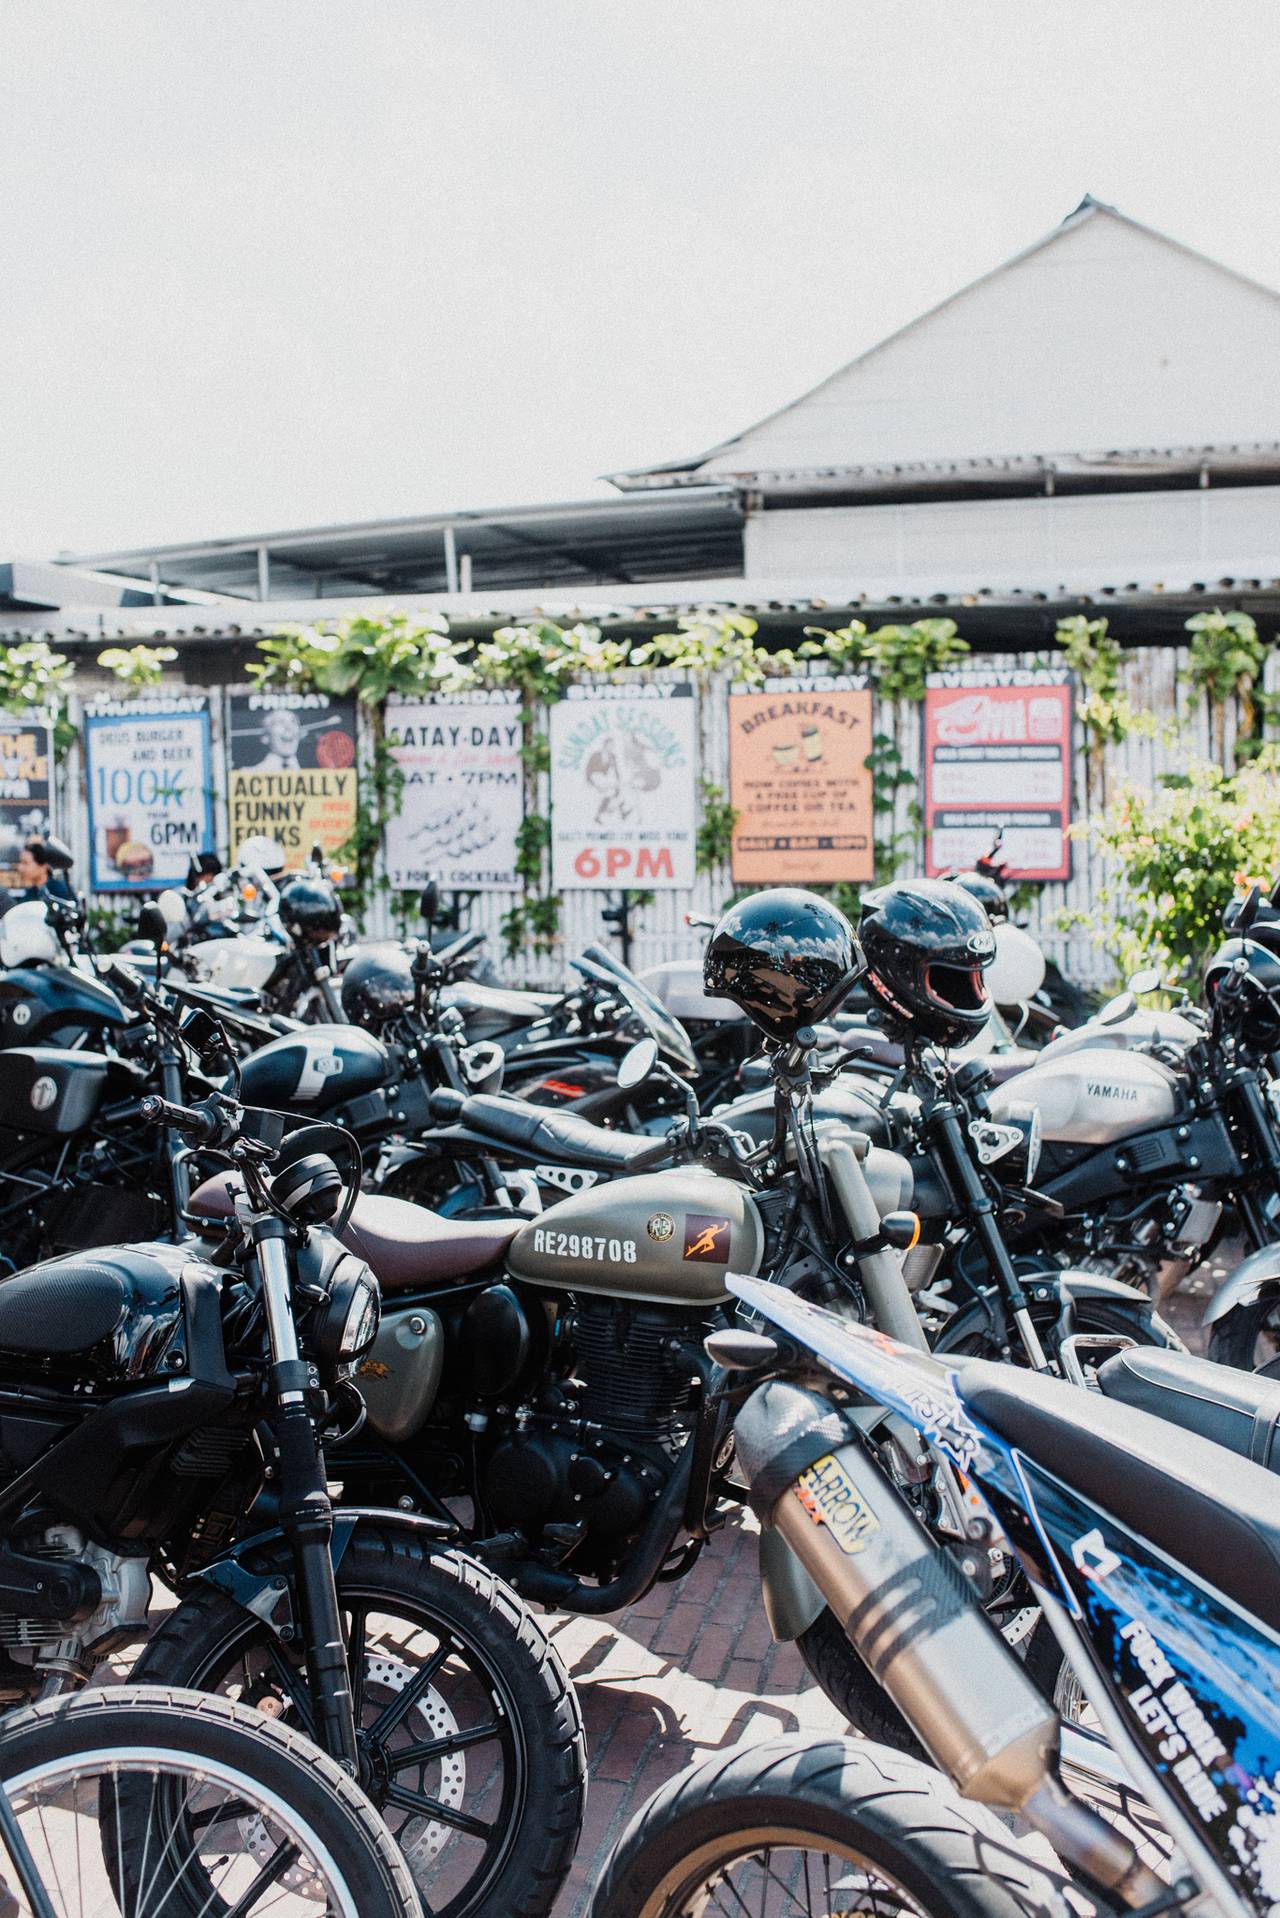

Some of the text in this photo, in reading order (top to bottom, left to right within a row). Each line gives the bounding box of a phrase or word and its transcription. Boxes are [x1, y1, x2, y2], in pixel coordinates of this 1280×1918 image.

[248, 694, 330, 711] FRIDAY
[567, 683, 676, 700] SUNDAY
[741, 702, 859, 734] BREAKFAST
[97, 767, 184, 807] 100K
[234, 775, 348, 797] ACTUALLY
[461, 771, 518, 785] 7PM
[234, 801, 305, 822] FUNNY
[150, 821, 199, 845] 6PM
[575, 847, 674, 878] 6PM
[1087, 1082, 1138, 1102] YAMAHA
[534, 1228, 638, 1265] RE298708
[802, 1461, 871, 1543] ARROW
[1119, 1619, 1227, 1768] FUCK WORK
[1127, 1684, 1228, 1824] LET'S RIDE
